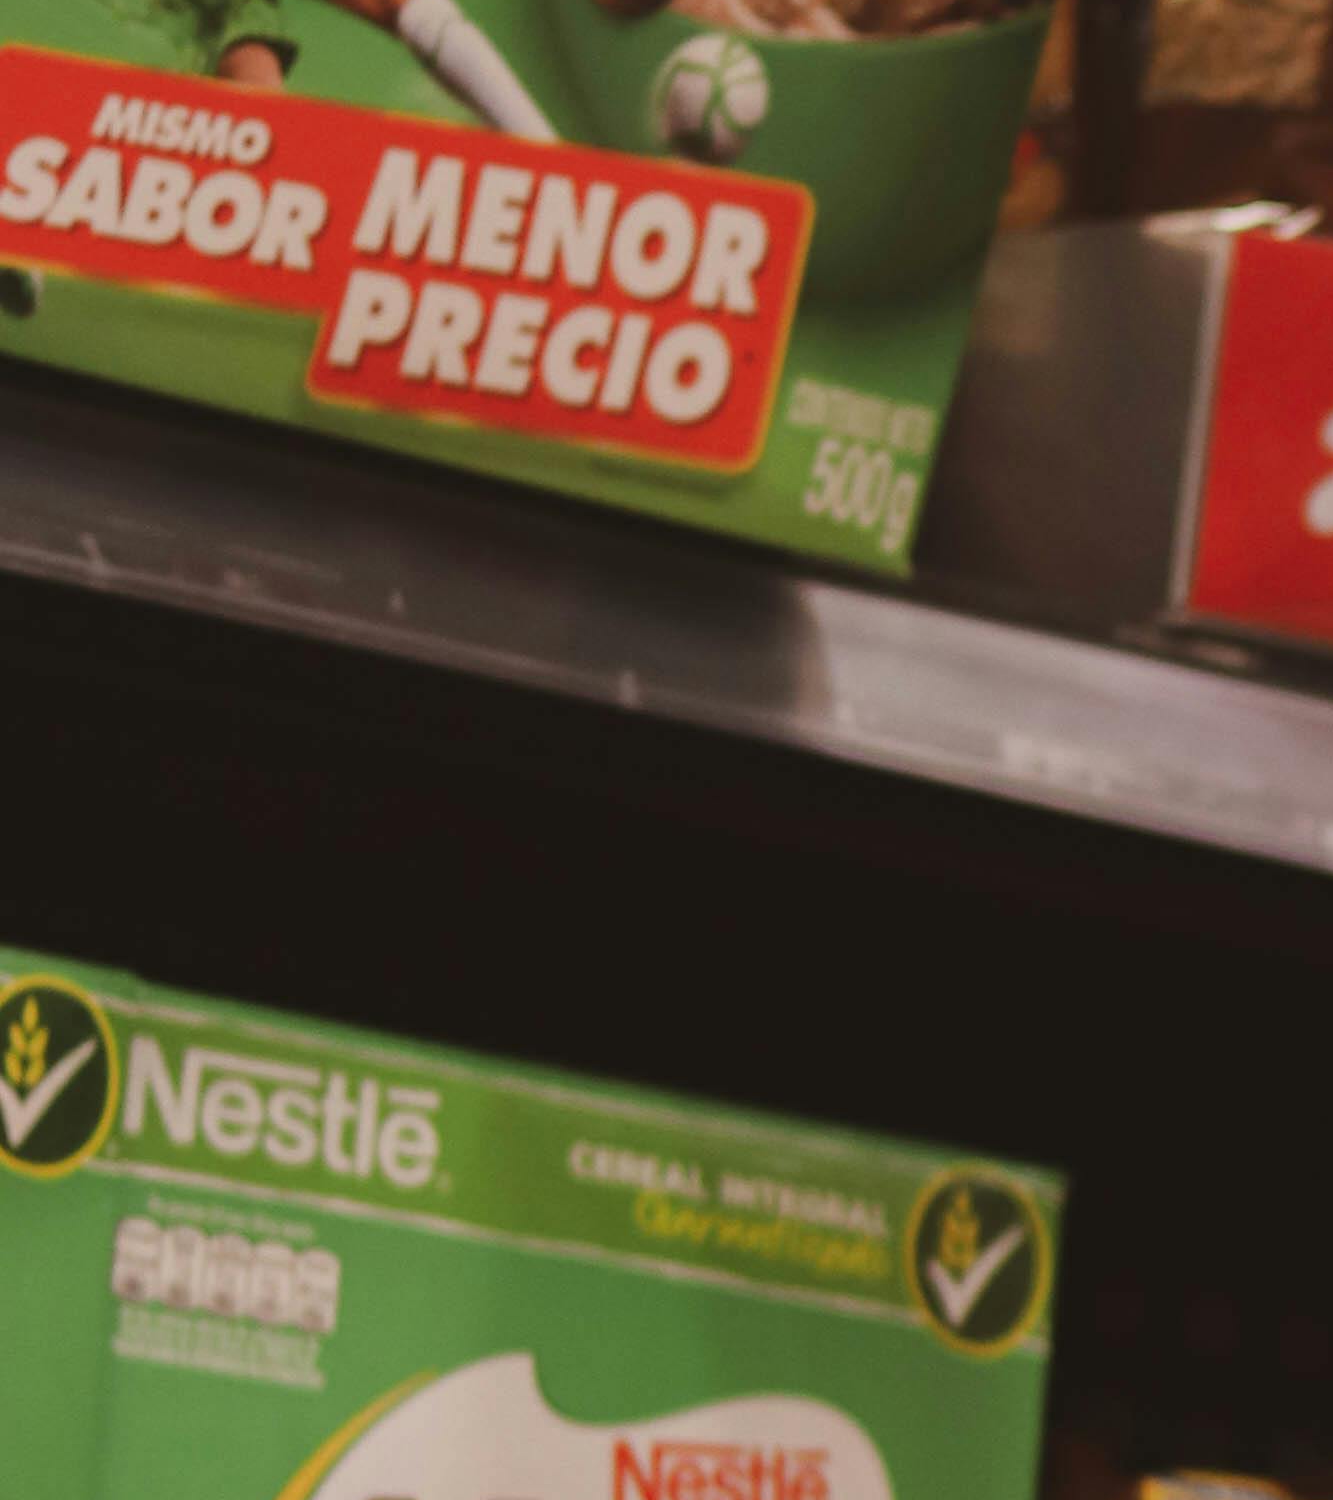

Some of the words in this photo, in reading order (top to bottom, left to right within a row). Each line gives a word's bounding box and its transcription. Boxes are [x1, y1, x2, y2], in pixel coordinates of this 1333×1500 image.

[91, 94, 271, 168] MISMO
[0, 137, 327, 271] SABOR
[352, 147, 769, 315] MENOR
[327, 270, 733, 424] PRECIO
[122, 1035, 442, 1188] Nestlé
[569, 1140, 706, 1200] CEREAL
[720, 1172, 889, 1238] INTEGRAL
